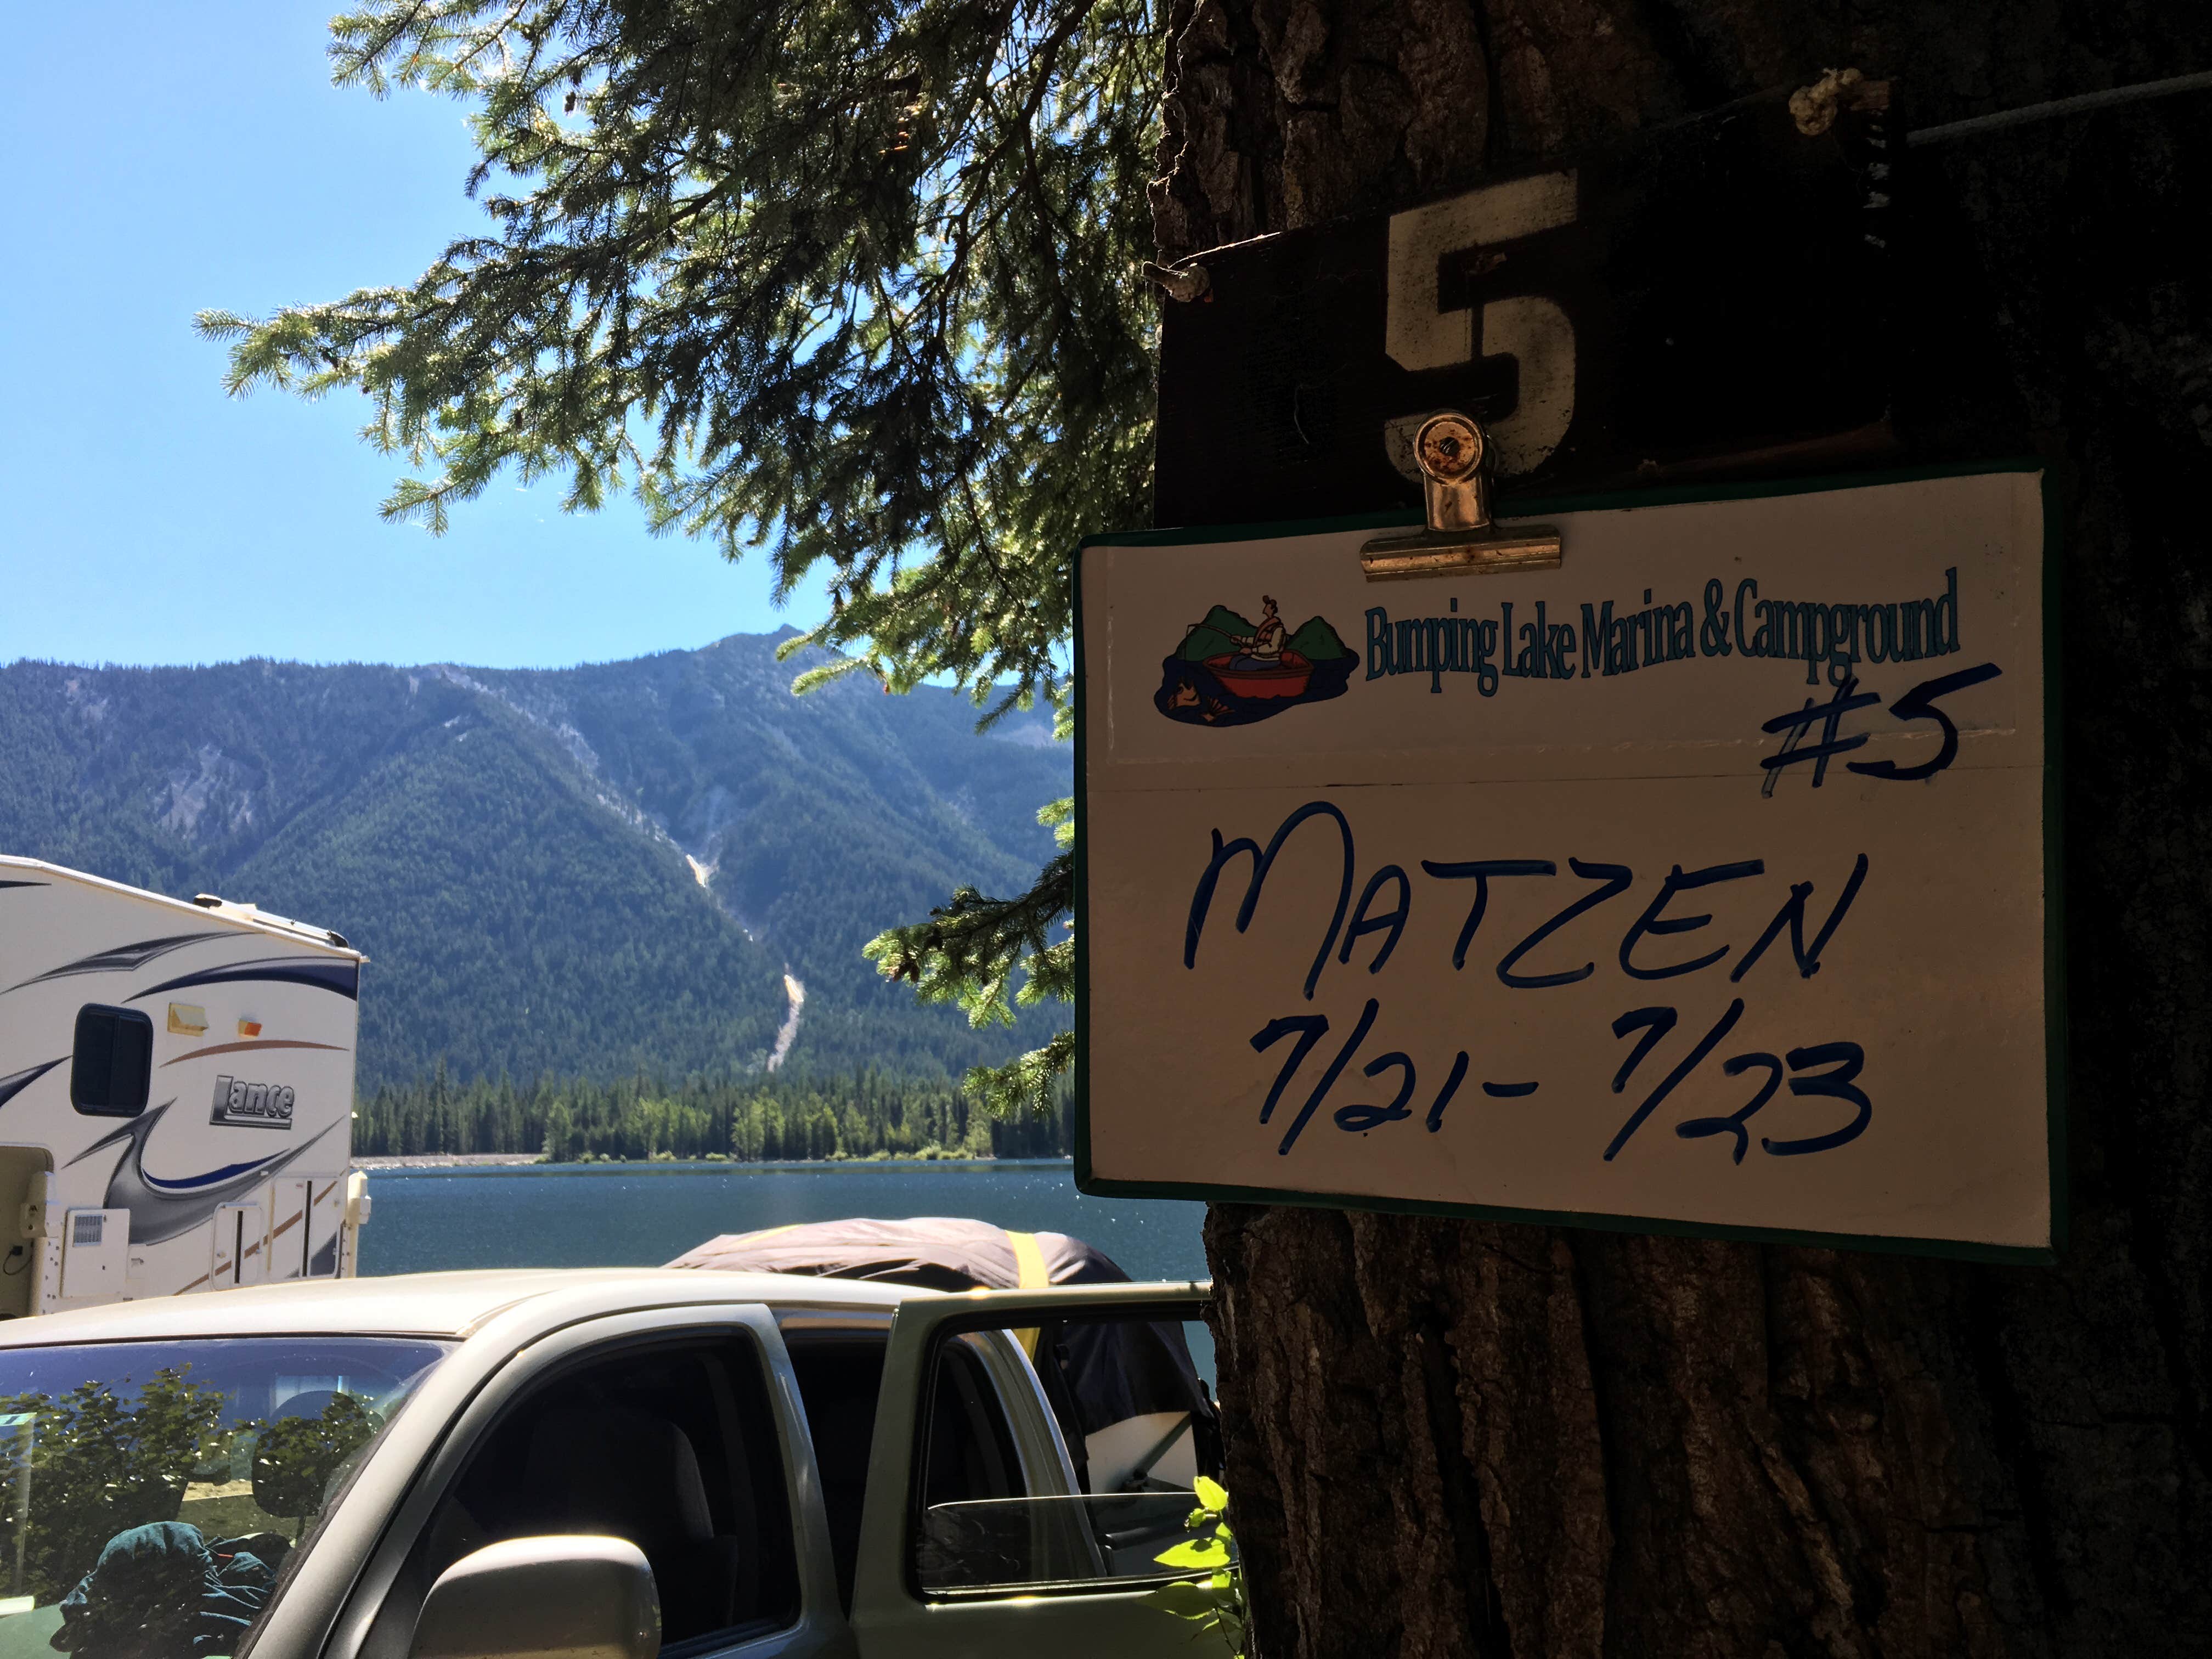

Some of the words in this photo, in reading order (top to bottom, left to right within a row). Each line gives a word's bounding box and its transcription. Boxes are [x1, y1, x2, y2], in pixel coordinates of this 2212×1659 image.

[1384, 166, 1579, 484] 5
[1364, 597, 1499, 697] Bumping
[1501, 601, 1577, 680] Lake
[1581, 588, 1696, 679] Marina
[1700, 578, 1733, 657] &
[1735, 566, 1961, 688] Campground
[1760, 662, 2003, 799] #5
[1183, 800, 1869, 1000] MATZEN
[208, 1074, 296, 1130] Lance
[1602, 997, 1873, 1165] 7/23
